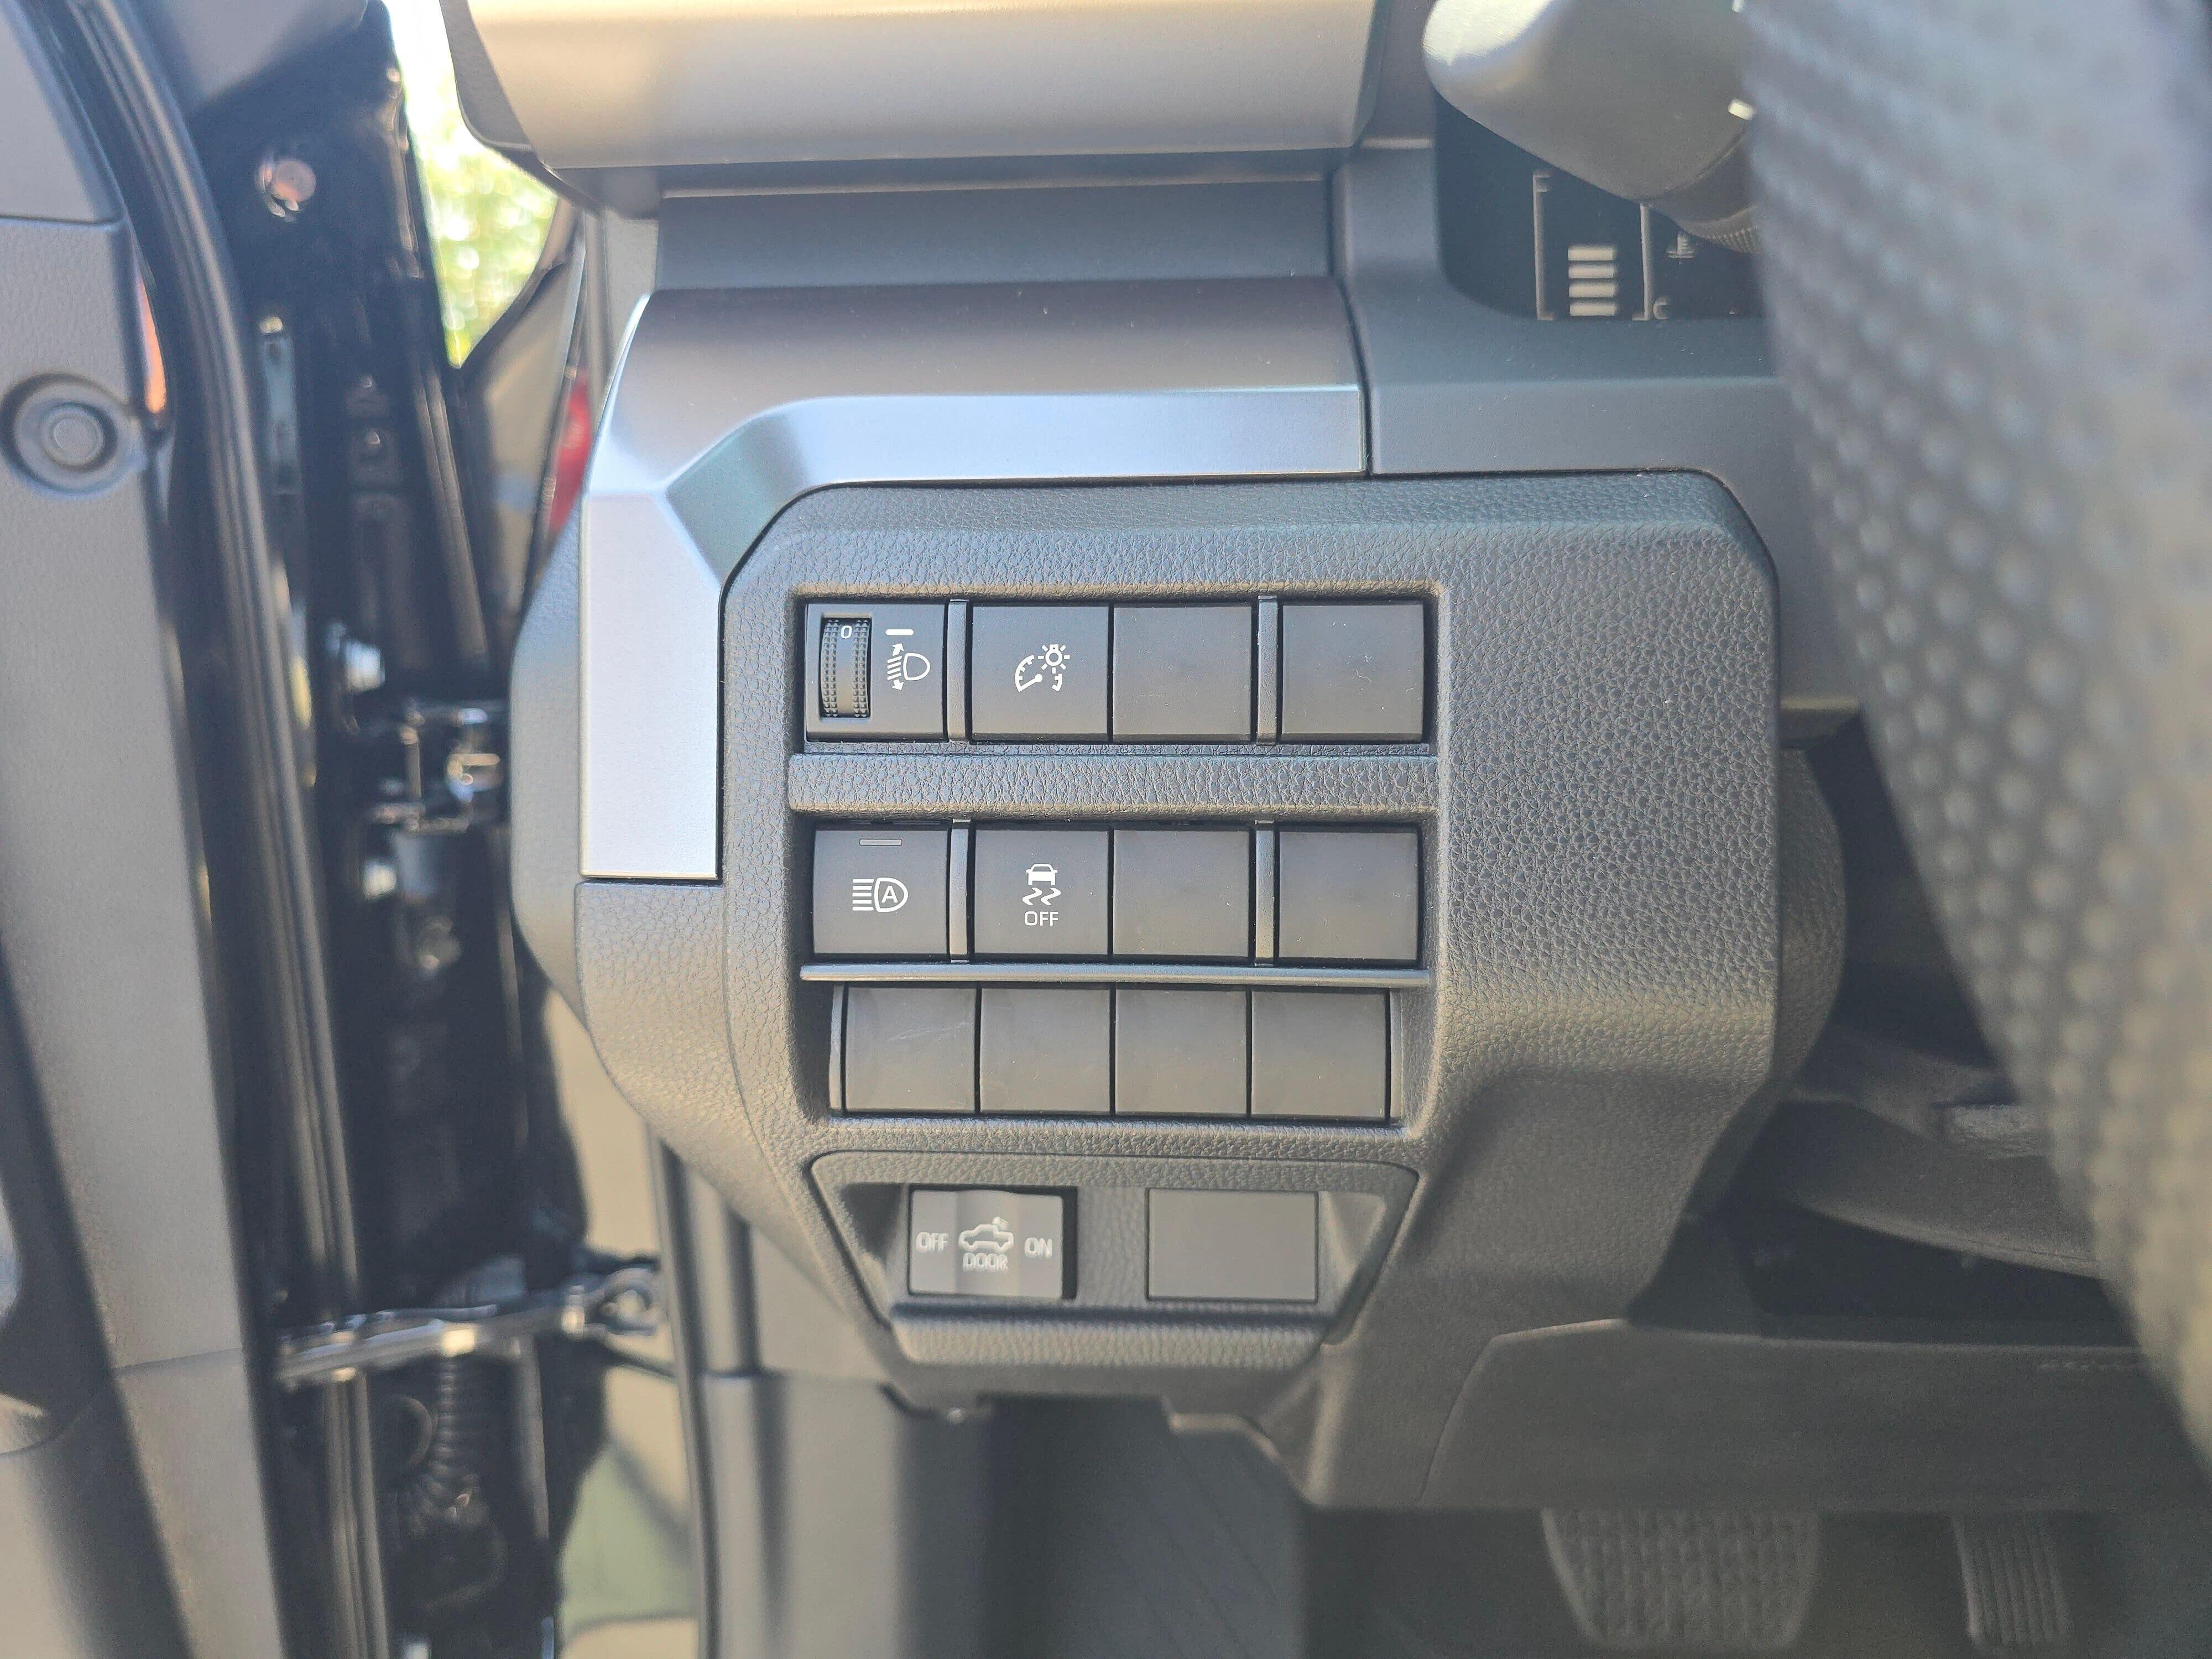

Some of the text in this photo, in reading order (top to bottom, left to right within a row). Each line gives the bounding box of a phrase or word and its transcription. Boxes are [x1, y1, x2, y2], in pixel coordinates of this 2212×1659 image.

[881, 886, 898, 902] A
[1025, 911, 1058, 926] OFF
[916, 1232, 950, 1252] OFF
[1024, 1237, 1052, 1258] ON
[963, 1253, 1008, 1271] DOOR
